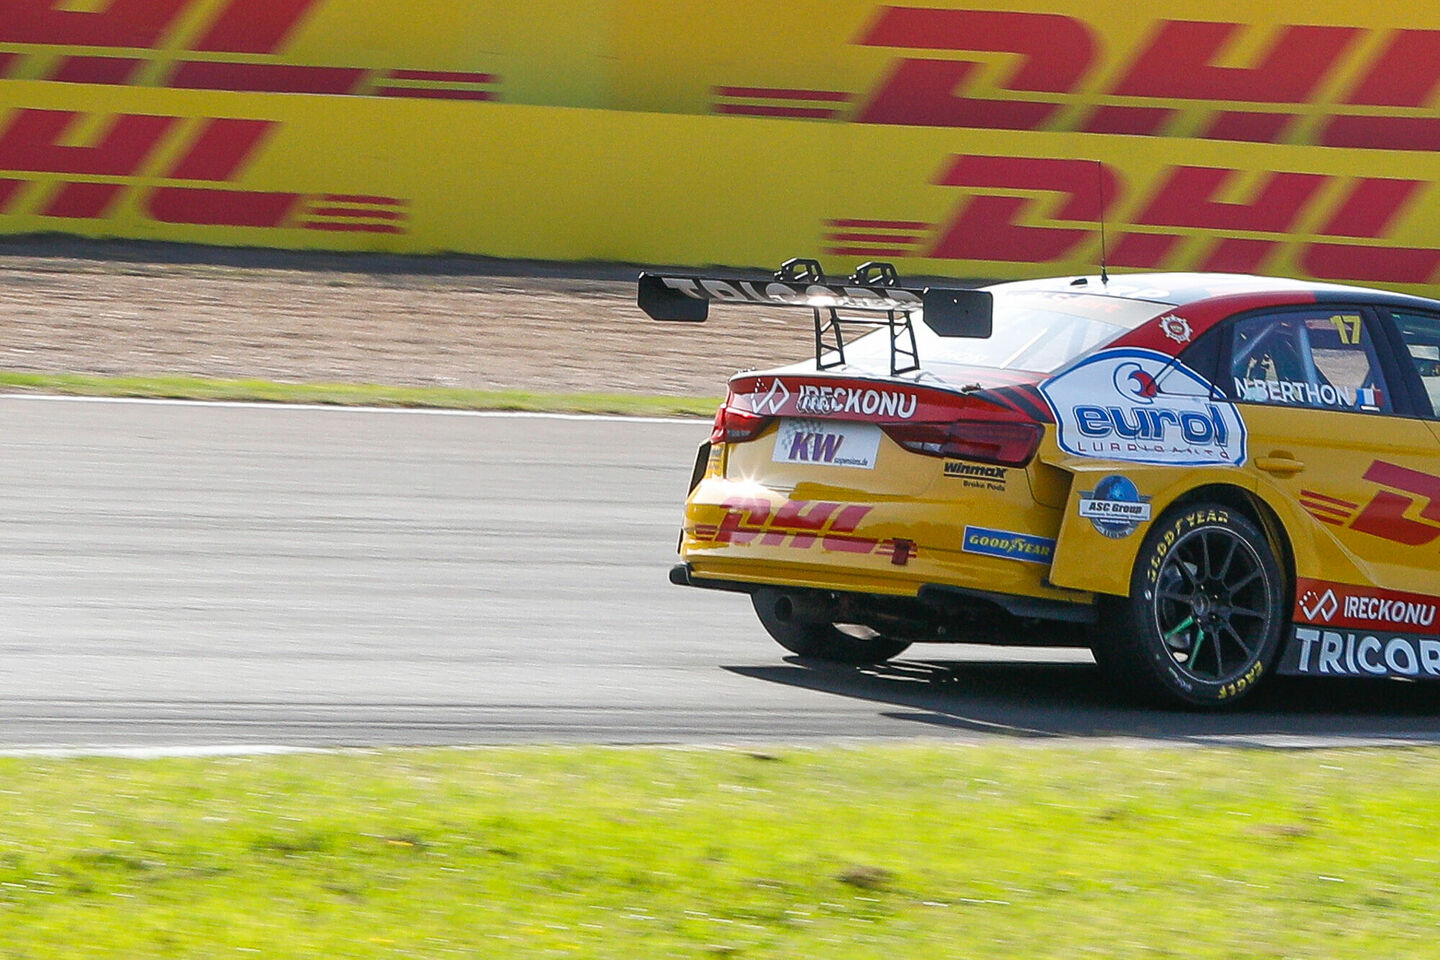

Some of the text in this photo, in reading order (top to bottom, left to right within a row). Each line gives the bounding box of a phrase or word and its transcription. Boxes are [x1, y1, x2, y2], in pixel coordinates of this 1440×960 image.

[0, 108, 300, 228] HL
[1328, 315, 1362, 345] 17
[1074, 403, 1228, 446] eurol
[789, 431, 845, 463] KW
[1089, 501, 1143, 514] ASC Group
[714, 497, 879, 554] DHL
[1343, 596, 1437, 626] IRECKONU
